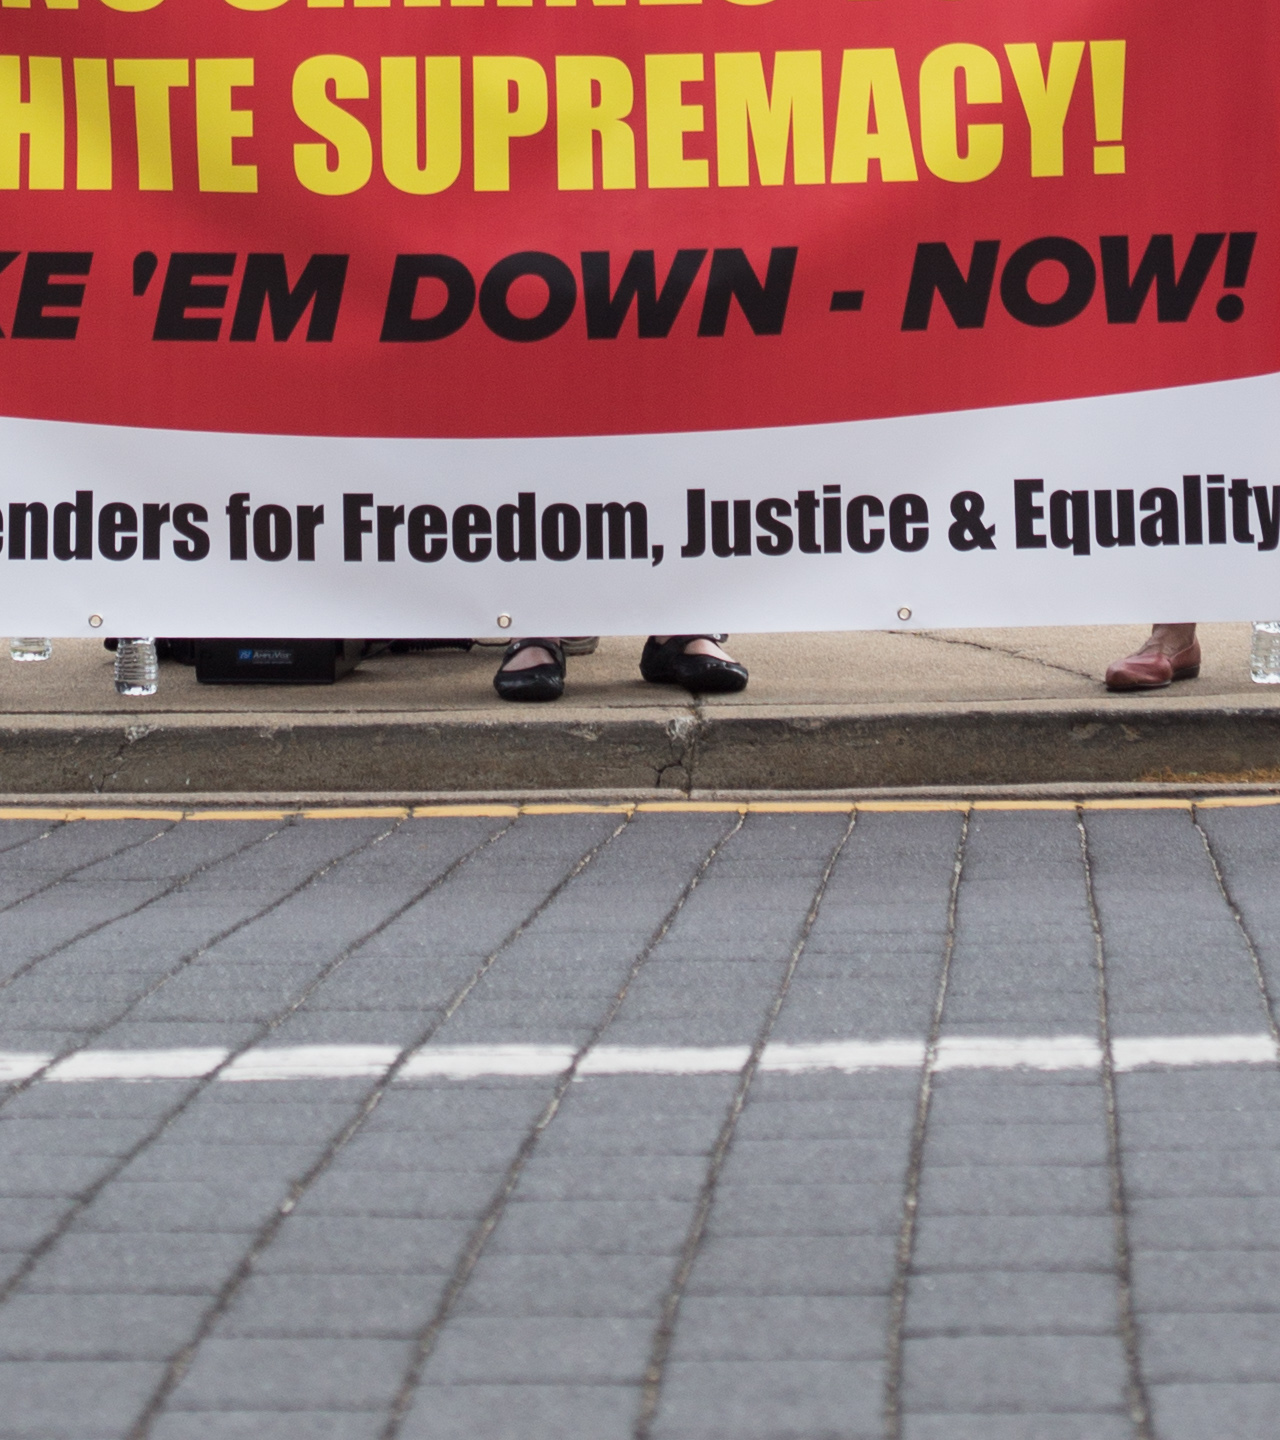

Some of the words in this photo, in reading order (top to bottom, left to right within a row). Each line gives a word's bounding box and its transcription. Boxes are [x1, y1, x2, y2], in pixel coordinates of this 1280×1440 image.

[291, 39, 1127, 196] SUPREMACY!
[133, 251, 350, 343] 'EM
[379, 246, 798, 344] DOWN
[901, 231, 1257, 332] NOW!
[225, 492, 325, 563] for
[342, 492, 664, 568] Freedom,
[680, 483, 930, 559] Justice
[948, 490, 996, 553] &
